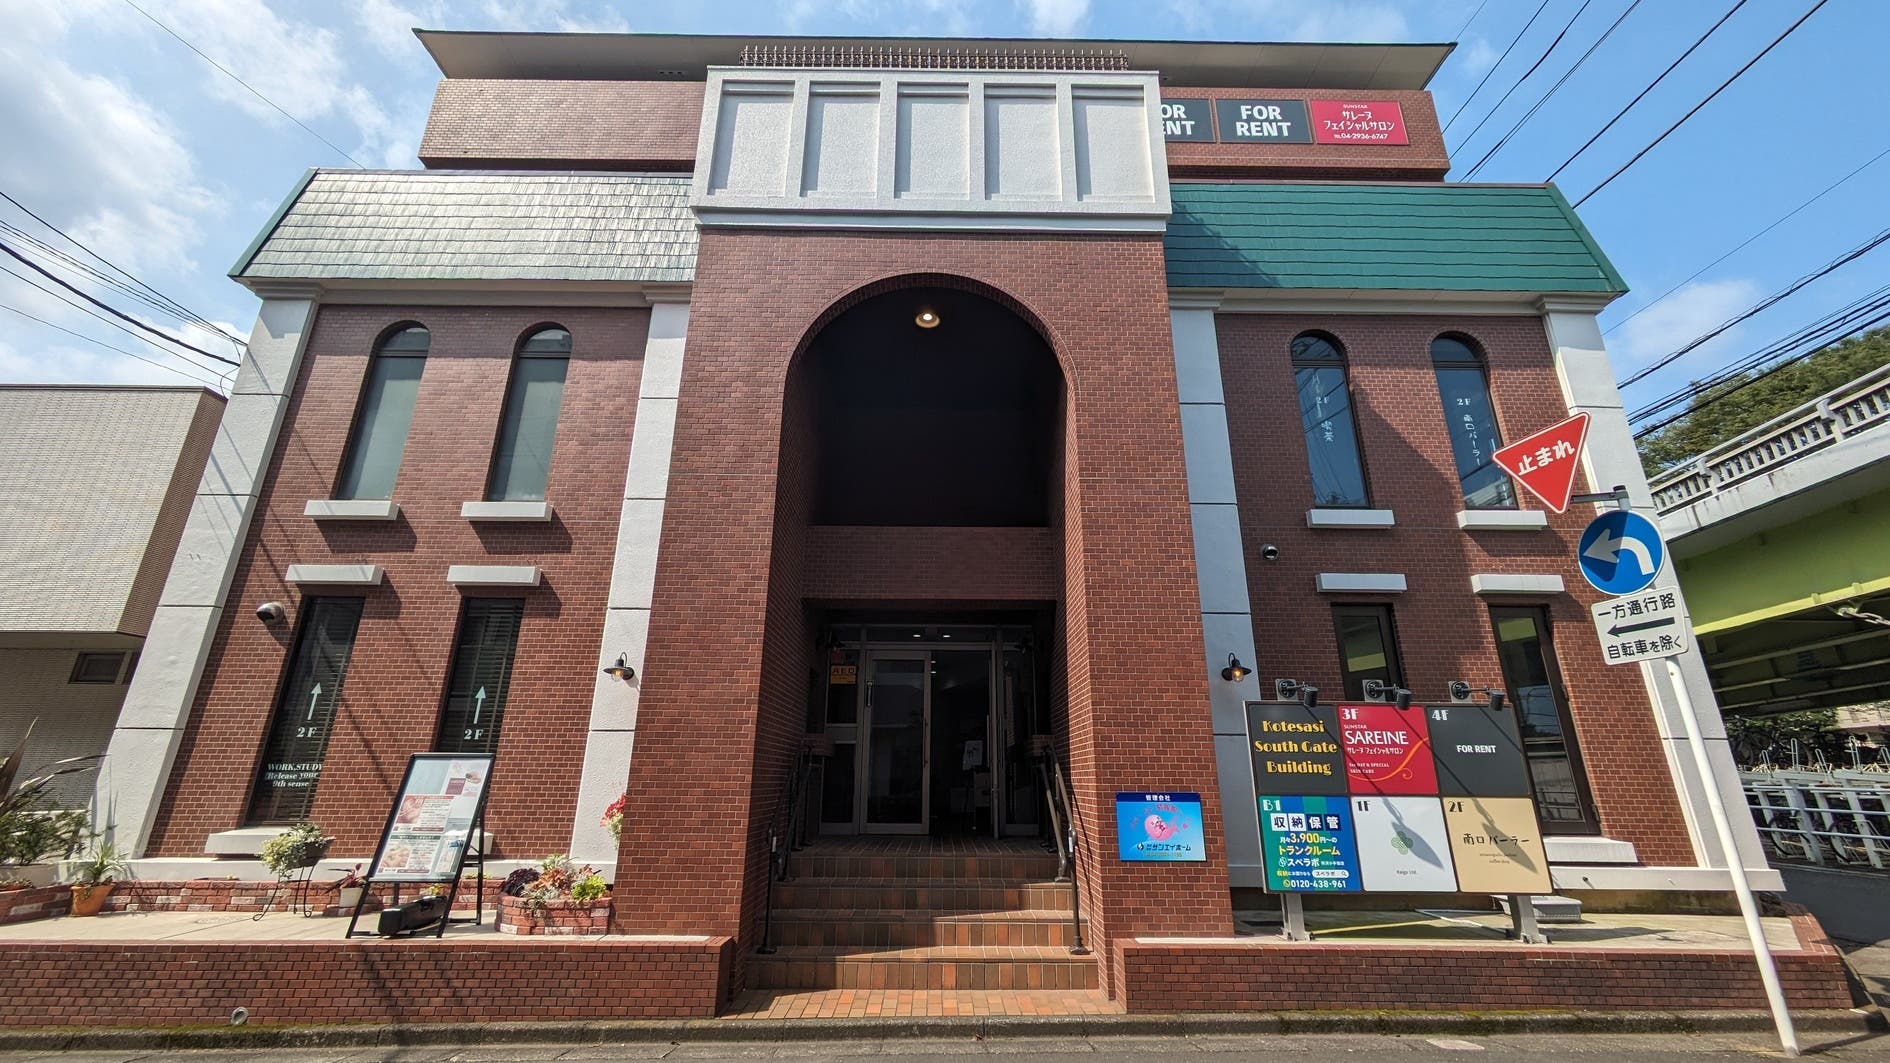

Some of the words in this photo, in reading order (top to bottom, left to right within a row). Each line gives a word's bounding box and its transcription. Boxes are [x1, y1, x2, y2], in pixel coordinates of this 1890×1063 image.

[1160, 104, 1187, 119] OR
[1240, 105, 1282, 120] FOR
[1342, 111, 1373, 121] サレーヌ
[1161, 121, 1195, 136] NT
[1235, 121, 1291, 137] RENT
[1323, 120, 1395, 131] フェイシャルサロン
[1456, 398, 1471, 406] 2F
[1518, 439, 1576, 477] 止まれ
[1597, 592, 1676, 620] 一方通行路
[1607, 634, 1682, 659] 自転車を除く
[1341, 708, 1359, 720] 3F
[1431, 709, 1449, 721] 4F
[295, 726, 318, 738] 2F
[1262, 720, 1325, 733] Kotesasi
[463, 728, 484, 740] 2F
[1344, 730, 1409, 745] SAREINE
[1254, 740, 1299, 753] South
[1301, 740, 1338, 753] Gate
[1365, 747, 1404, 755] フェイシャルサロン
[1456, 744, 1474, 753] FOR
[1474, 744, 1497, 753] RENT
[1266, 760, 1332, 776] Building
[1262, 799, 1281, 811] B1
[1355, 800, 1371, 811] 1F
[1448, 801, 1464, 812] 2F
[1273, 816, 1339, 829] 収納保管
[1279, 845, 1341, 856] トランクルーム
[1290, 880, 1346, 888] 0120-438-961
